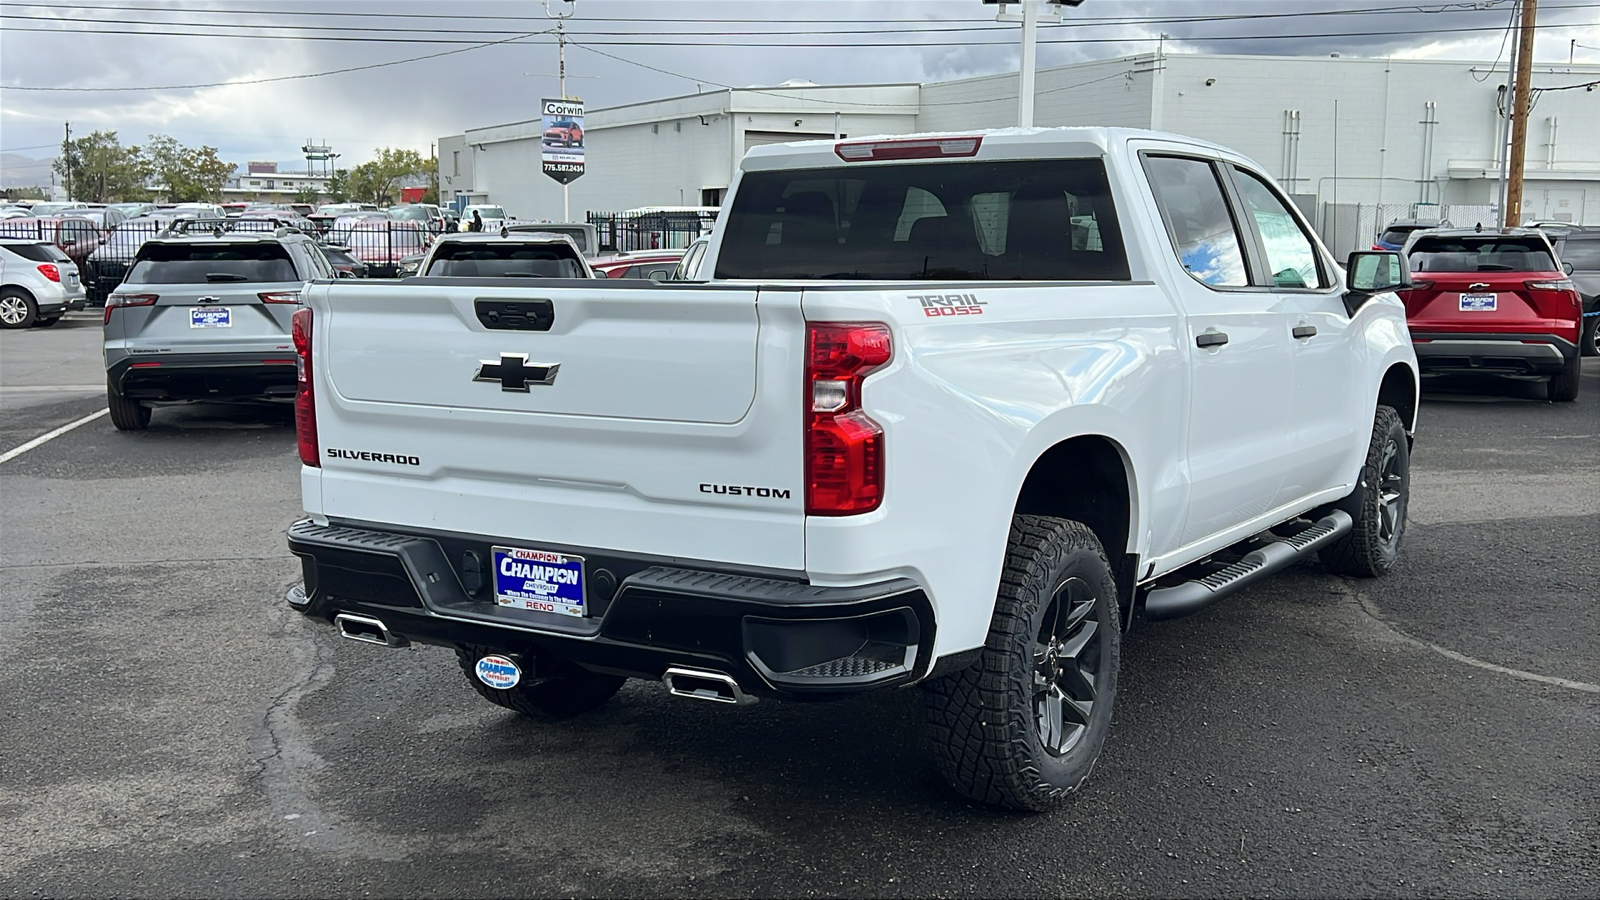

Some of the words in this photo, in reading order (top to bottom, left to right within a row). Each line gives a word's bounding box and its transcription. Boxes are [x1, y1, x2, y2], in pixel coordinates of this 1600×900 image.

[547, 103, 583, 116] Corwin
[907, 294, 988, 307] TRAIL
[193, 311, 228, 319] CHAMPION
[924, 305, 983, 317] BOSS
[327, 448, 420, 466] SILVERADO
[699, 483, 791, 499] CUSTOM
[515, 550, 558, 563] CHAMPION
[500, 557, 579, 586] CHAMPION
[525, 581, 556, 592] CHEVROLET
[526, 601, 554, 612] RENO
